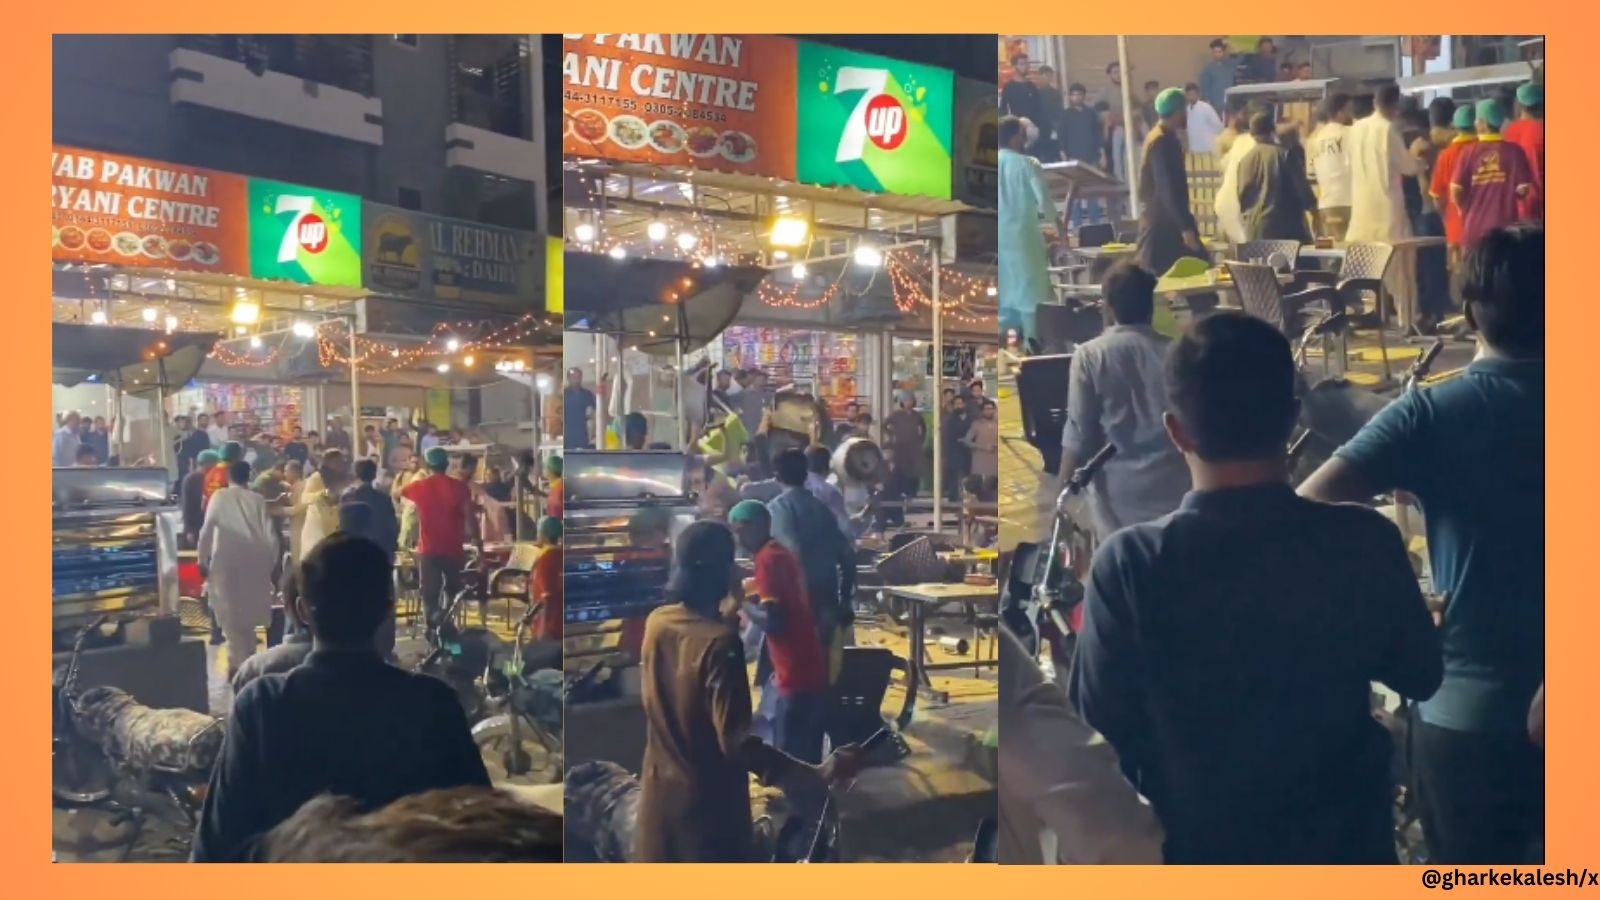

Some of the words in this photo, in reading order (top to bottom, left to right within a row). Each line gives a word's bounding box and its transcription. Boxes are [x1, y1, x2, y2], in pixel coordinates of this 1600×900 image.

[563, 52, 622, 91] ANI
[630, 64, 758, 111] CENTRE
[99, 160, 209, 197] PAKWAN
[127, 195, 220, 228] CENTRE
